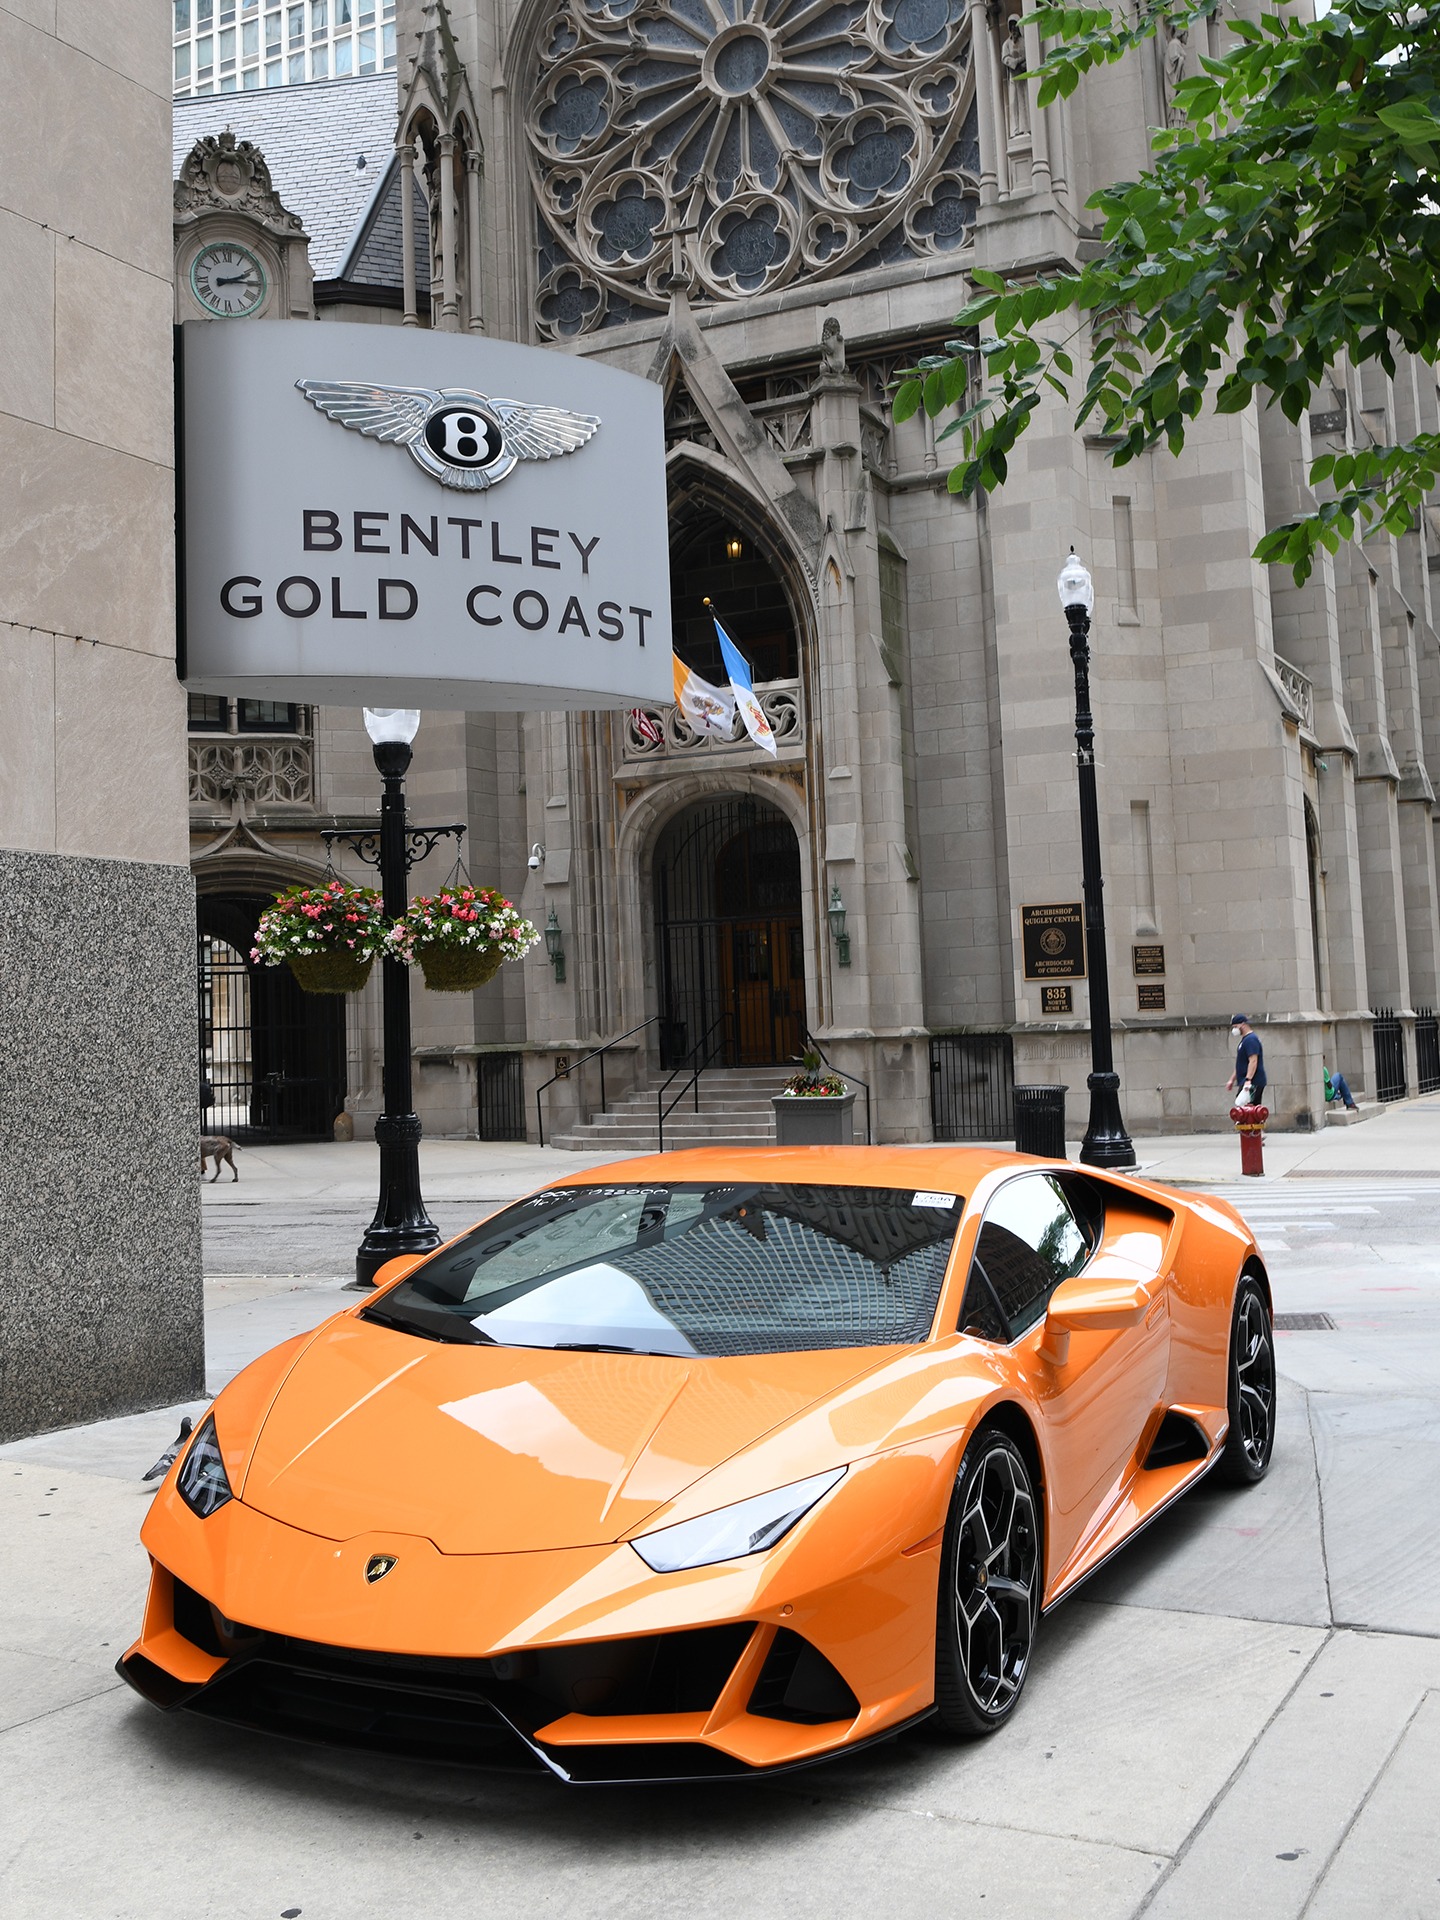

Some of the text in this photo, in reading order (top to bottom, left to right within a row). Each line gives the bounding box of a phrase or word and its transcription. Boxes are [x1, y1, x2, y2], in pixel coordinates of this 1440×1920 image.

[442, 411, 490, 462] B
[303, 509, 601, 574] BENTLEY
[219, 575, 653, 647] GOLD COAST
[1030, 907, 1073, 917] ARCHBISHOP
[1024, 915, 1081, 926] QUIGLEY CENTER
[1034, 959, 1075, 968] ARCHDIOCESE
[1046, 987, 1067, 1000] 835
